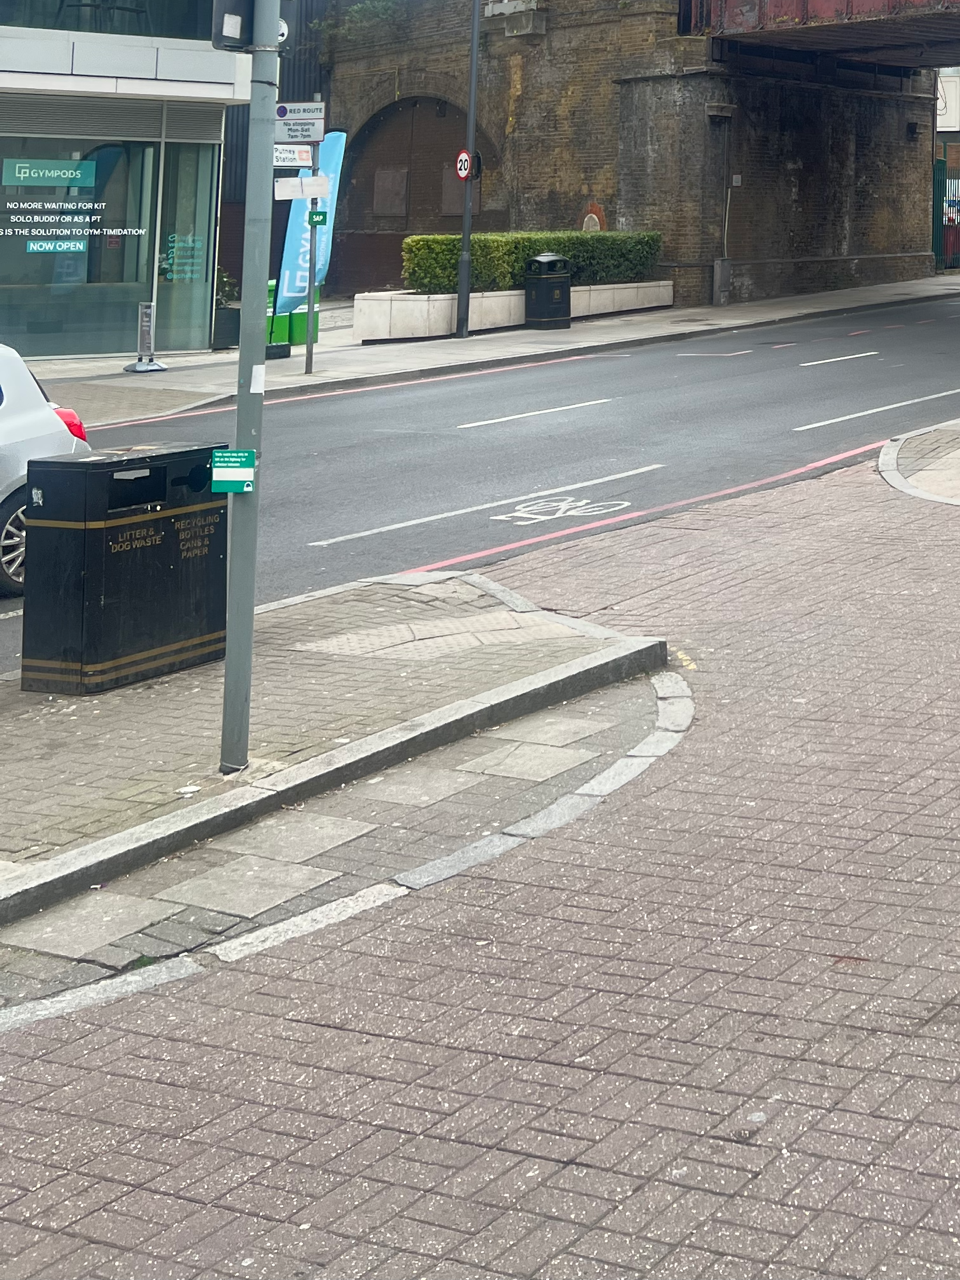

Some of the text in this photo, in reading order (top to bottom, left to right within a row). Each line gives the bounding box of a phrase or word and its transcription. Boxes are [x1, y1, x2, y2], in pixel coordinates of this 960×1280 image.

[274, 147, 295, 155] Putney
[459, 159, 469, 171] 20
[31, 169, 82, 179] GYMPODS
[60, 215, 72, 223] OR
[73, 215, 84, 223] AS
[85, 215, 90, 223] A
[91, 215, 101, 223] PT
[312, 214, 323, 222] SAP
[5, 228, 13, 236] IS
[14, 228, 29, 236] THE
[30, 228, 70, 236] SOLUTION
[71, 228, 82, 236] TO
[29, 241, 83, 251] NOW OPEN
[174, 514, 220, 530] RECYCLING
[118, 528, 147, 541] LITTER
[179, 525, 215, 540] BOTTLES
[111, 535, 162, 553] DOG WASTE
[180, 537, 210, 550] CANS &
[181, 546, 208, 559] PAPER
